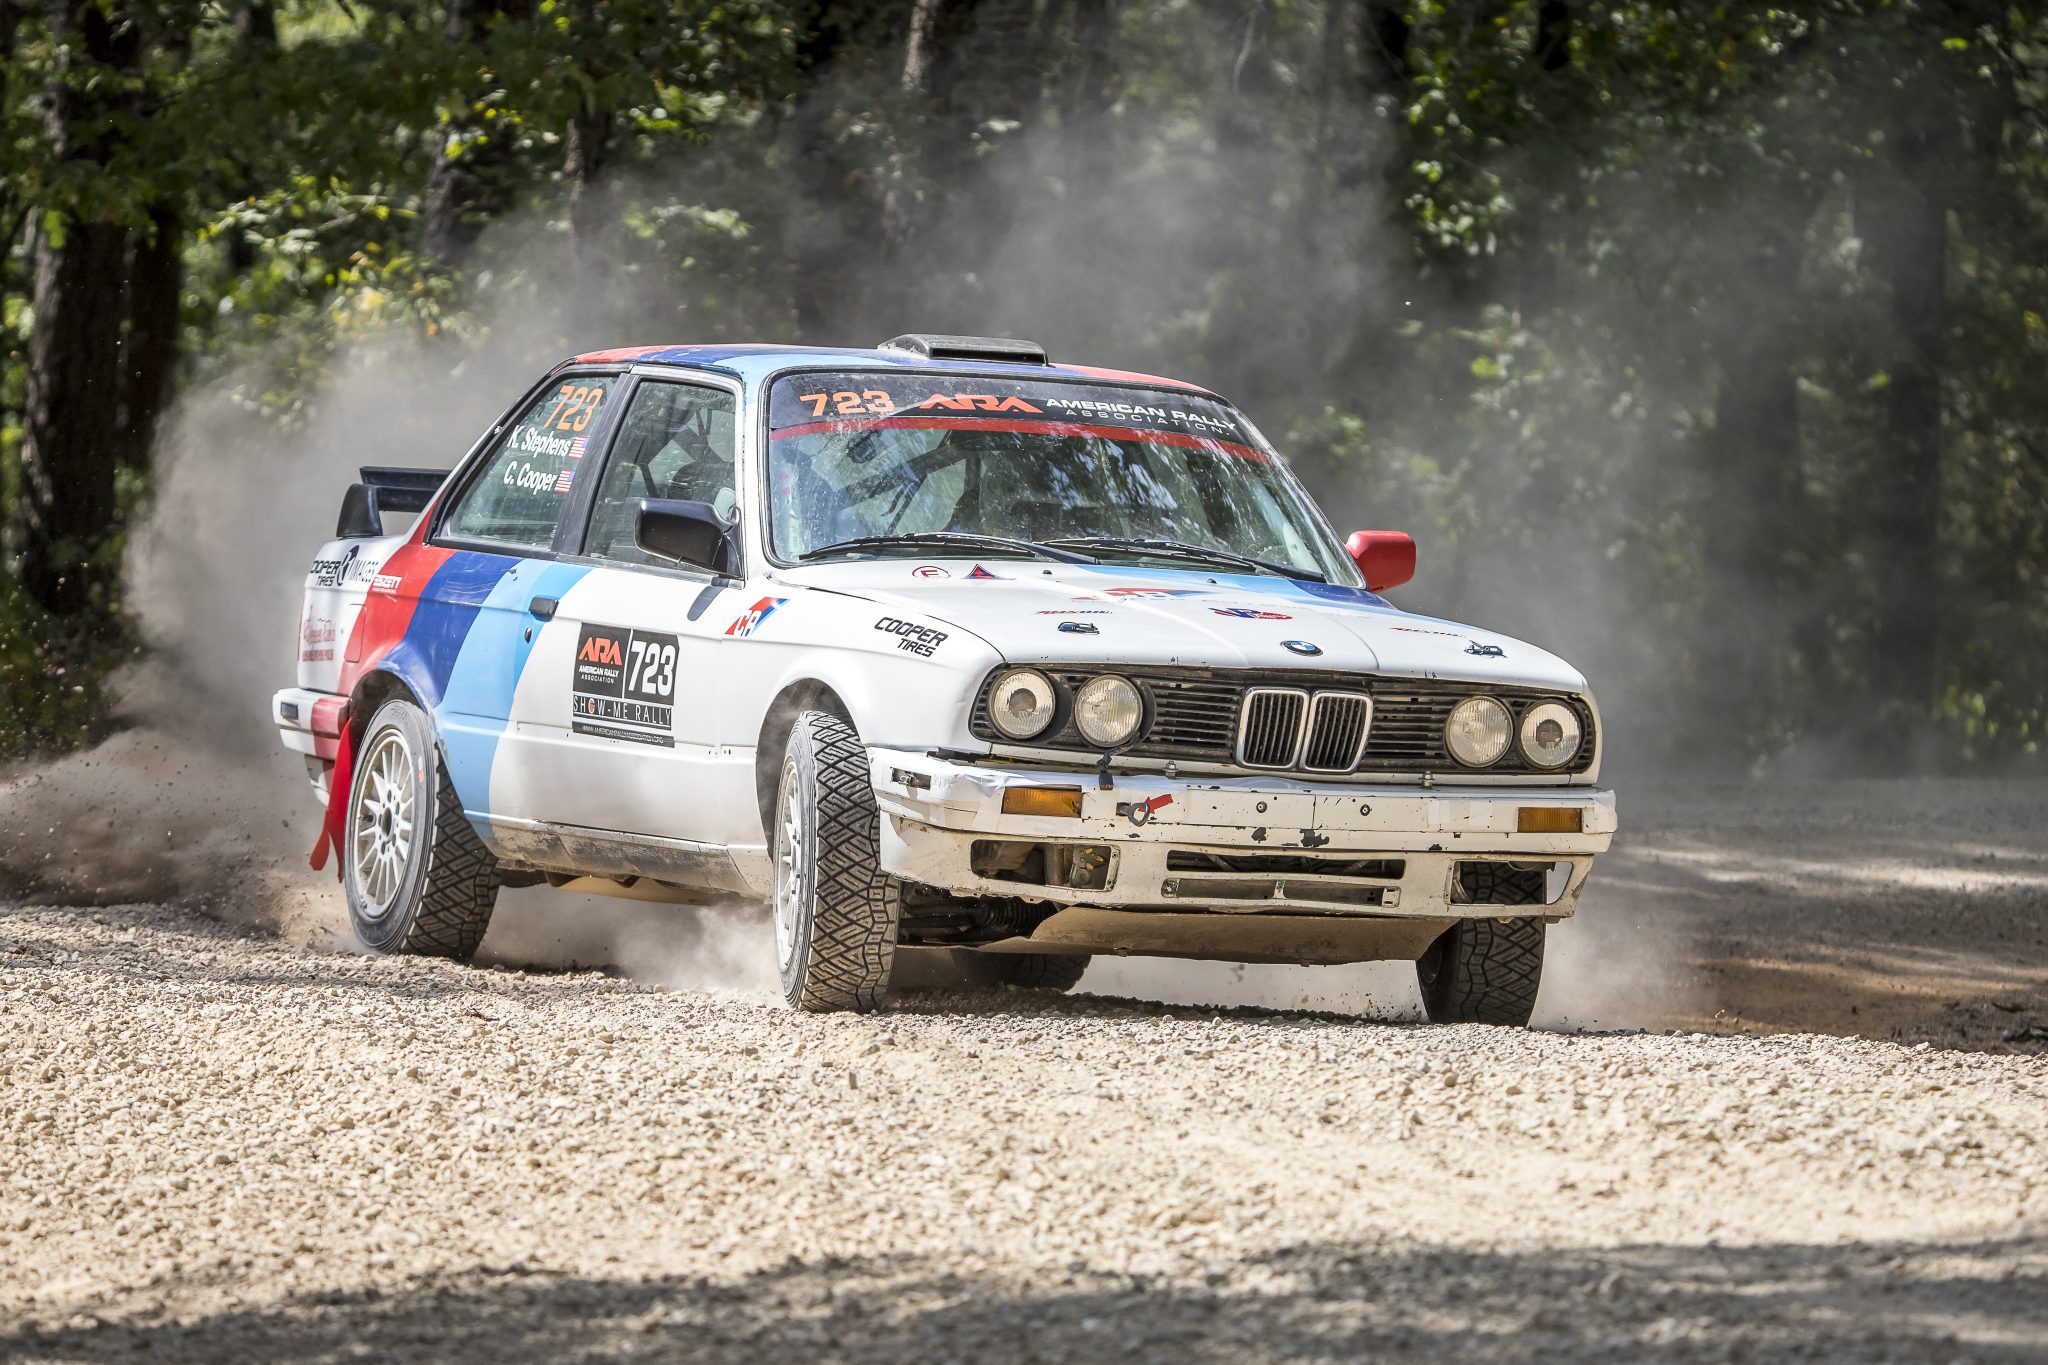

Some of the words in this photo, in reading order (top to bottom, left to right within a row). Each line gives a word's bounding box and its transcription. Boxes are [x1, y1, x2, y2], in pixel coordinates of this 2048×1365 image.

[544, 385, 604, 432] 723
[800, 389, 895, 416] 723
[919, 393, 1044, 413] ARA
[1046, 398, 1166, 417] AMERICAN
[1171, 410, 1236, 430] RALLY
[507, 425, 525, 448] K.
[520, 427, 571, 458] Stephens
[503, 460, 518, 485] C.
[517, 462, 557, 495] Cooper
[874, 616, 949, 647] COOPER
[578, 636, 623, 666] ARA
[897, 638, 937, 658] TIRES
[579, 665, 604, 676] AMERICAN
[604, 668, 620, 678] RALLY
[581, 673, 614, 684] ASSOCIATION
[628, 640, 676, 697] 723
[573, 695, 628, 719] SHOW-ME
[635, 704, 671, 725] RALLY
